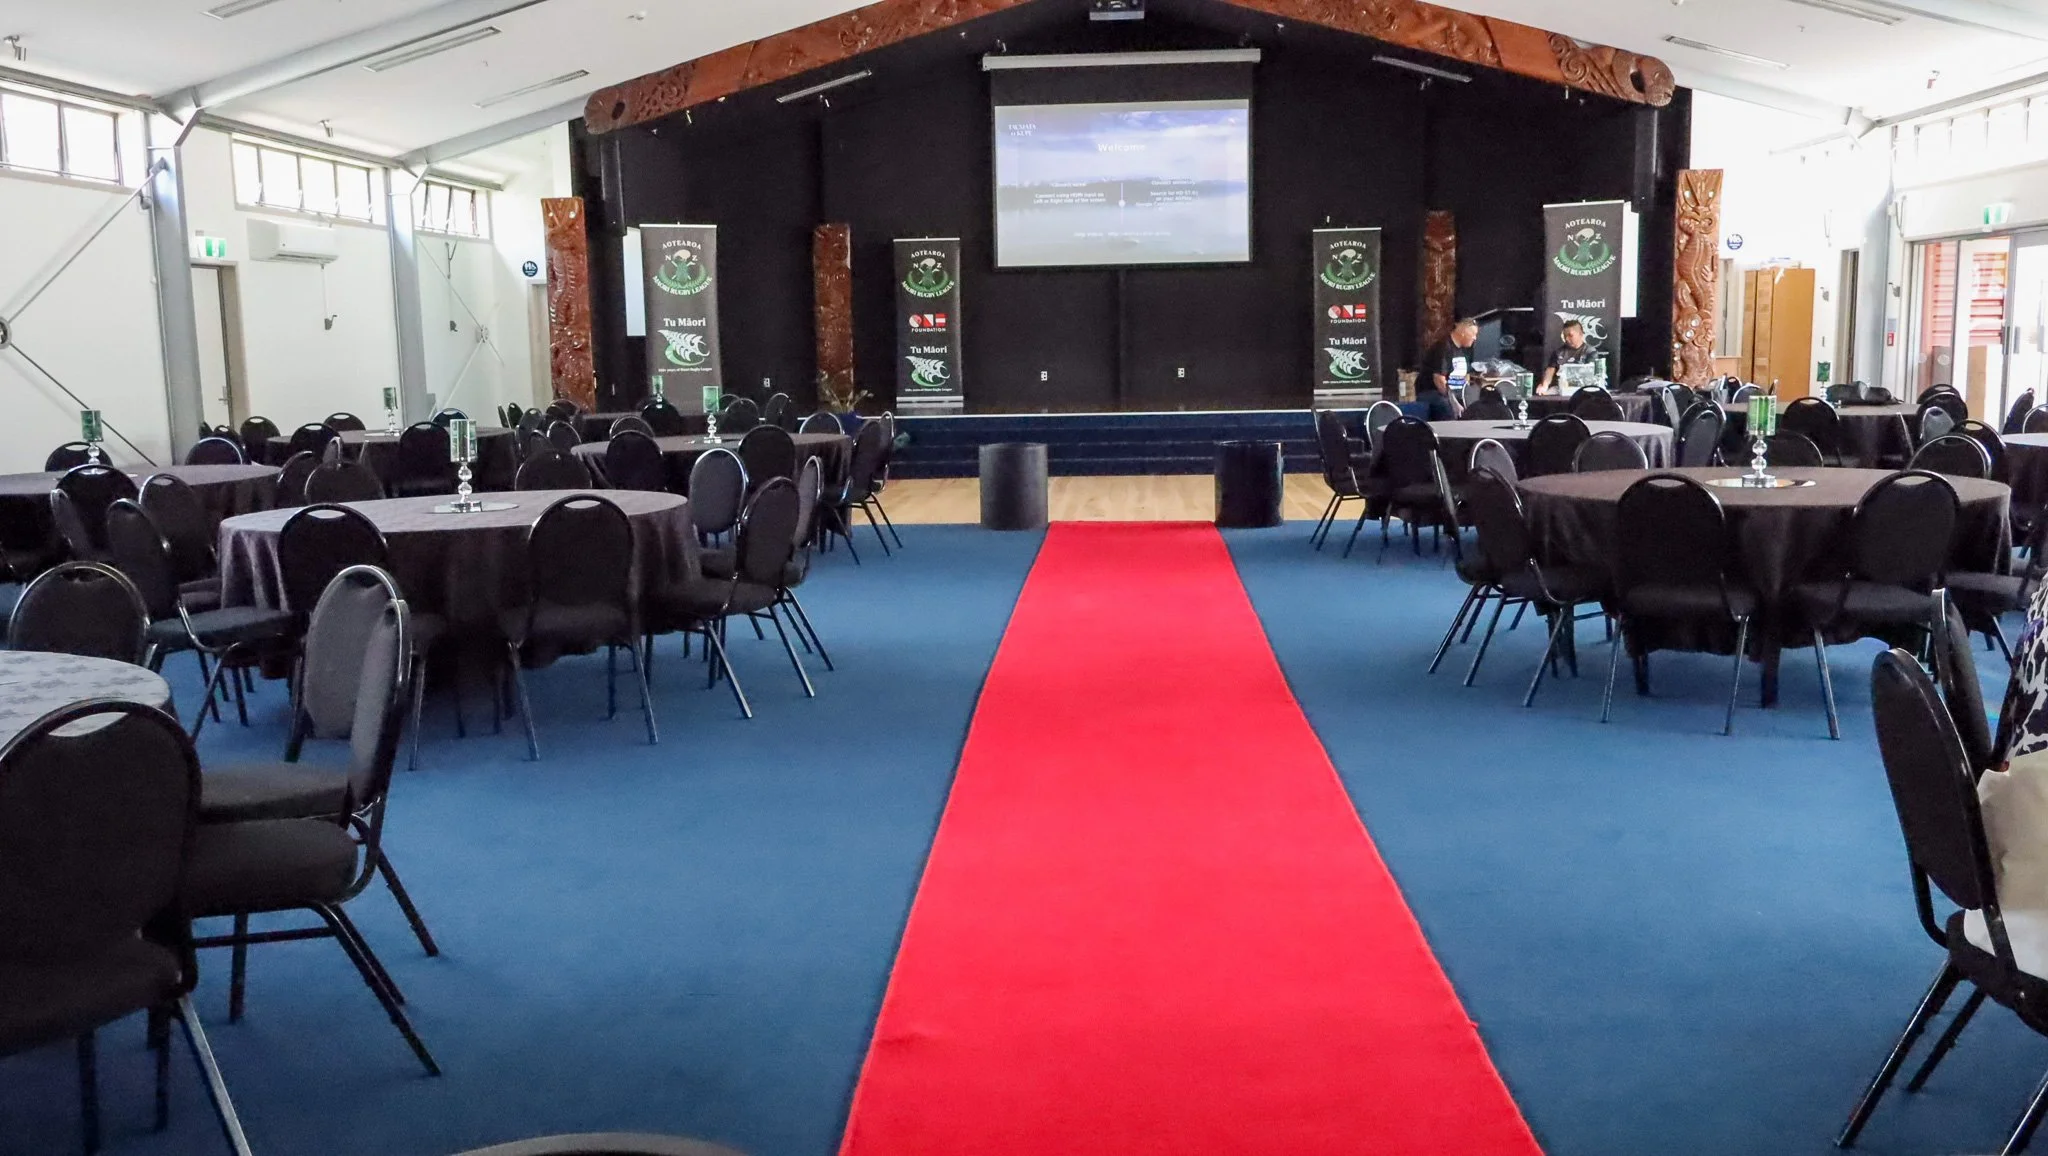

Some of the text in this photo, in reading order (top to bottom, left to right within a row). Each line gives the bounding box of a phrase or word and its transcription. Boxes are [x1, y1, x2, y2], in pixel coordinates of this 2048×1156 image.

[1097, 143, 1146, 152] Welcome
[1565, 218, 1606, 228] AOTEAROA
[662, 240, 702, 250] AOTEAROA
[1330, 240, 1366, 250] AOTEAROA
[911, 250, 946, 258] AOTEAROA
[1592, 254, 1616, 274] LEAGUE
[692, 276, 712, 294] LEAGUE
[1356, 272, 1376, 288] LEAGUE
[936, 280, 954, 296] LEAGUE
[1561, 300, 1574, 308] Tu
[663, 318, 676, 326] Tu
